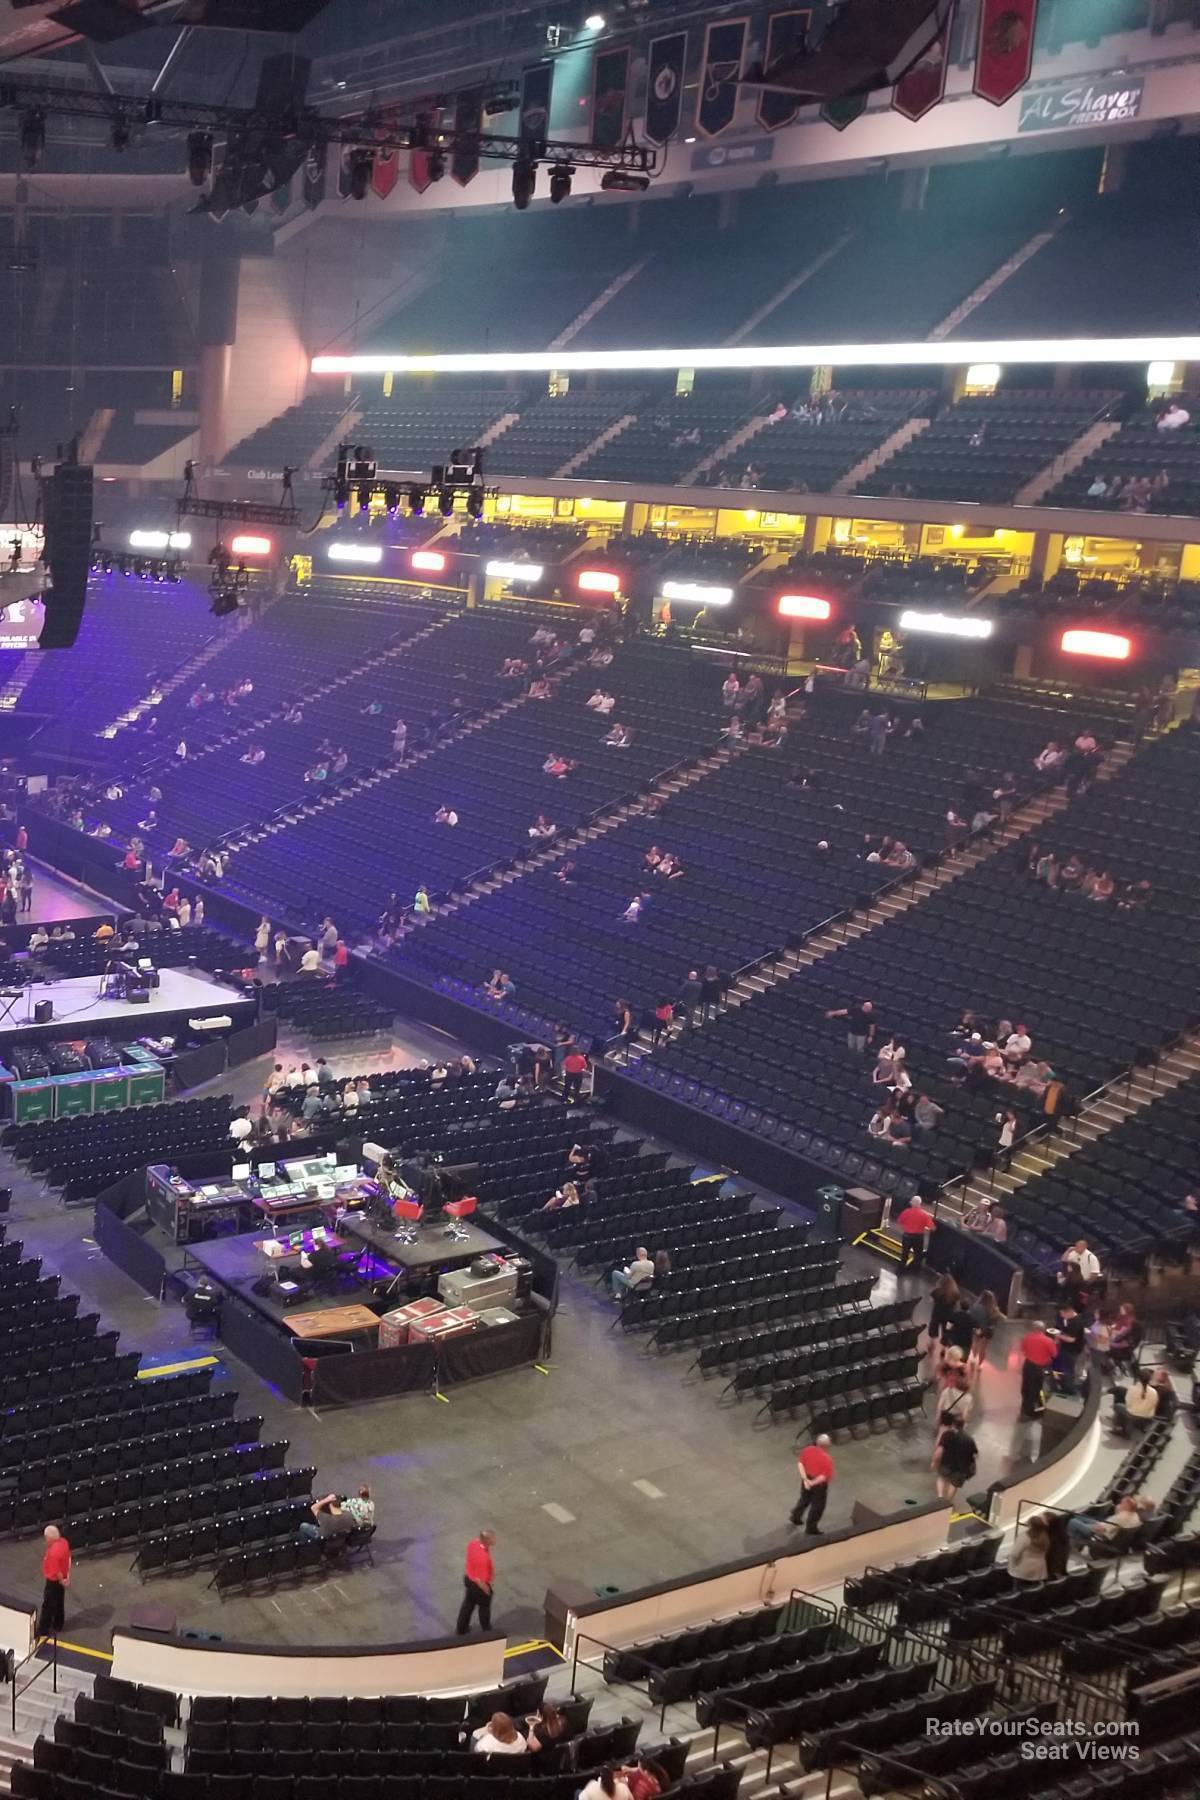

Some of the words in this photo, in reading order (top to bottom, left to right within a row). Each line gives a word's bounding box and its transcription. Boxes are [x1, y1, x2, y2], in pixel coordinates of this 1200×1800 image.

[1107, 104, 1139, 120] BOX
[247, 469, 266, 479] Club
[267, 471, 285, 480] Leve
